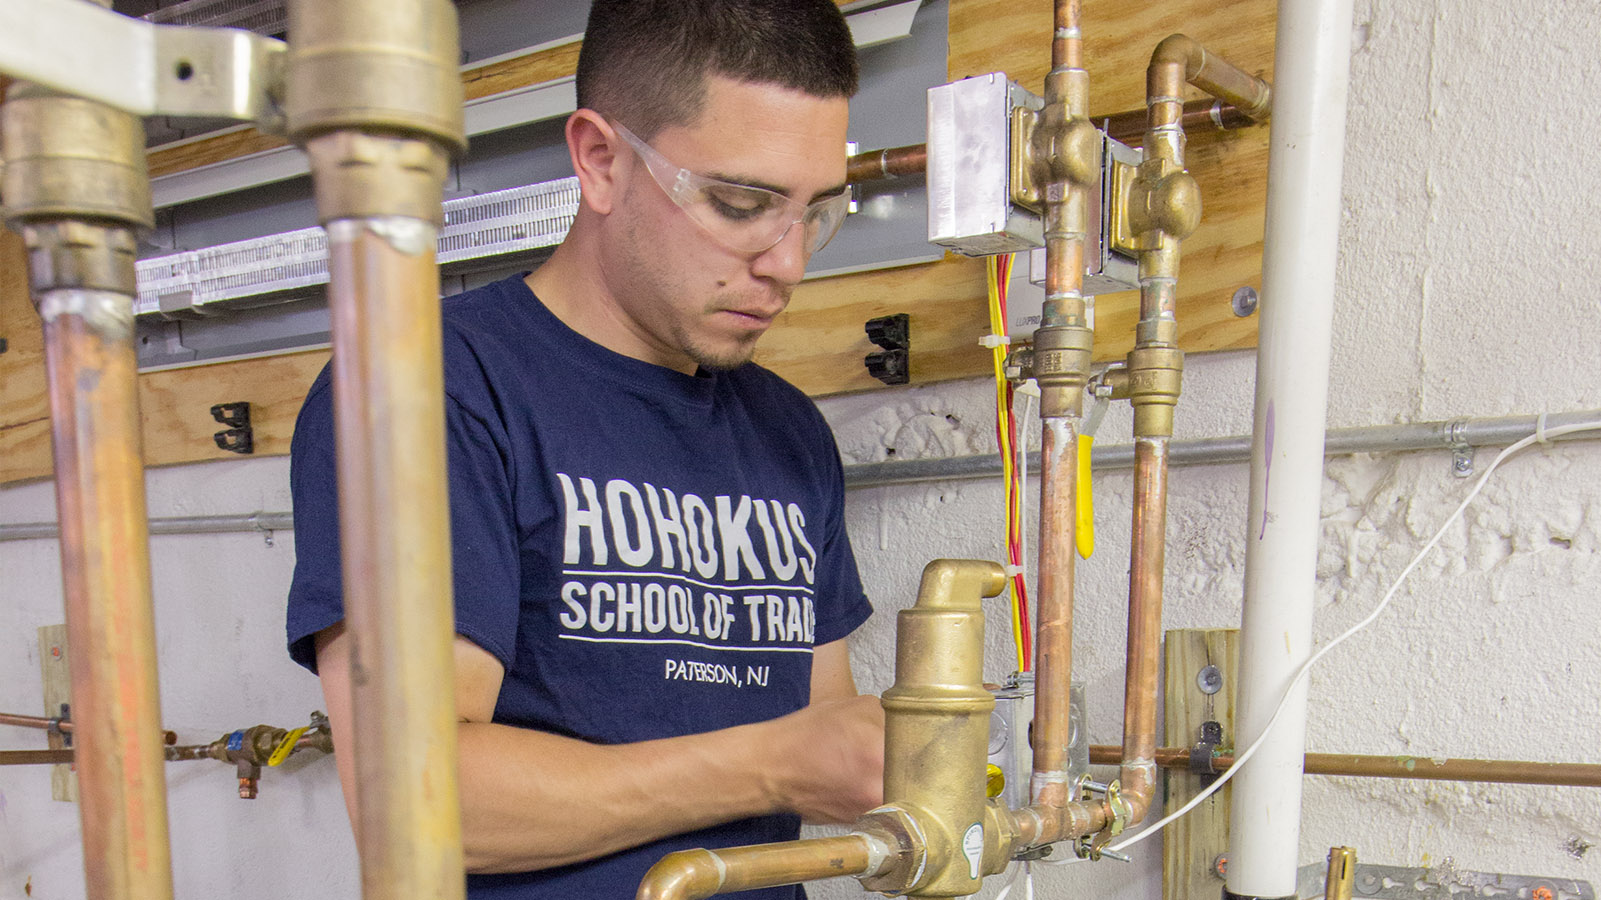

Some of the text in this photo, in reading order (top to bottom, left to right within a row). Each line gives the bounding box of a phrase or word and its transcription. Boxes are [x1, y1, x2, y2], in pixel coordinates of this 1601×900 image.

[556, 473, 816, 584] HOHOKUS
[560, 581, 699, 635] SCHOOL
[703, 592, 735, 640] OF
[665, 659, 769, 688] PATERSON, NJ
